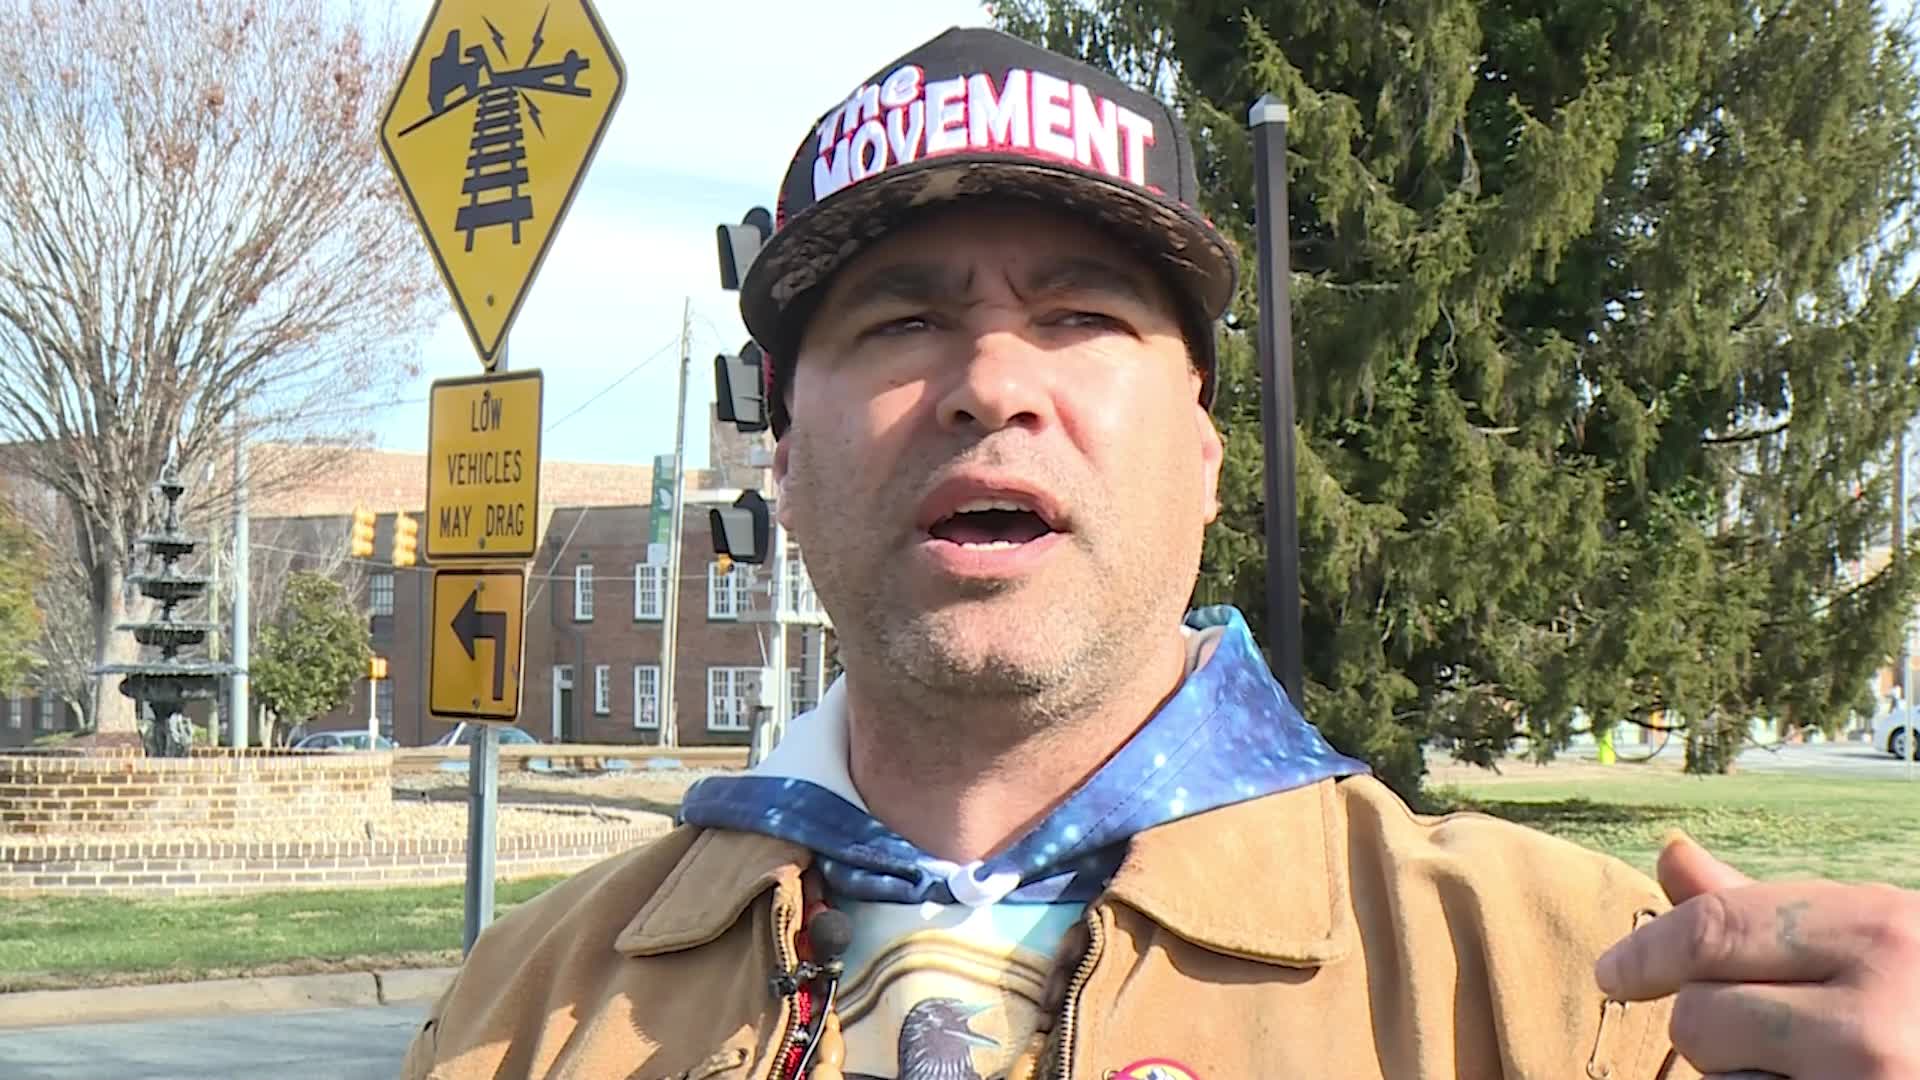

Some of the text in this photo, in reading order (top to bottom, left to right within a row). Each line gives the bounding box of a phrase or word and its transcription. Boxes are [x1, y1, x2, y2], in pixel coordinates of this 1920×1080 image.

[814, 69, 1156, 201] MOVEMENT
[471, 398, 502, 432] LOW
[448, 450, 522, 485] VEHICLES
[440, 503, 524, 538] MAY DRAG
